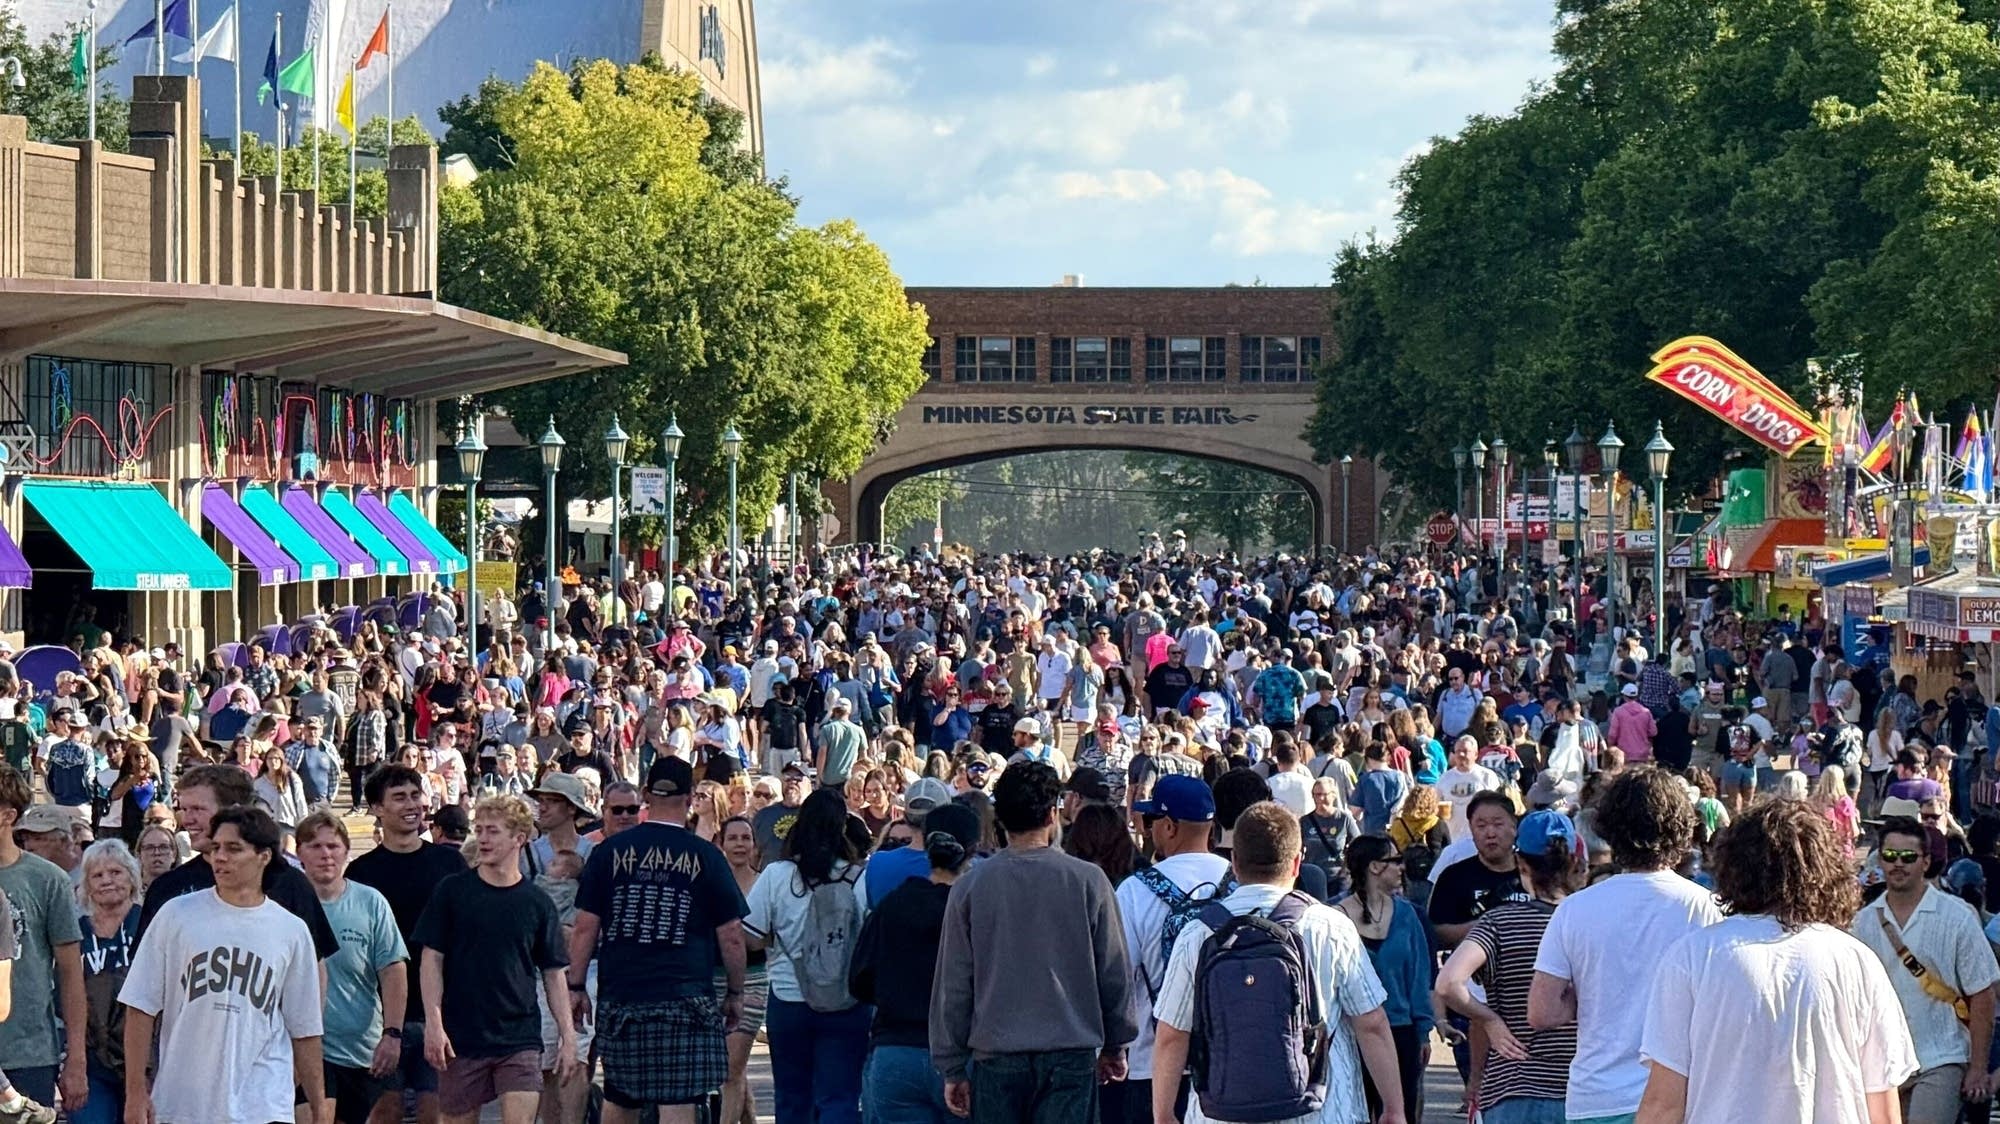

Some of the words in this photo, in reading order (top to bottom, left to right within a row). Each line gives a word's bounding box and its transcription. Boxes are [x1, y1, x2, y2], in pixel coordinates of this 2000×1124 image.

[1676, 363, 1736, 407] CORN
[1740, 402, 1802, 446] DOGS
[922, 406, 1077, 425] MINNESOTA
[1082, 406, 1165, 425] STATE
[1172, 406, 1252, 425] FAIR
[1429, 523, 1453, 535] STOP
[1970, 601, 1987, 609] OLD
[613, 845, 637, 880] DEF
[639, 845, 702, 882] LEPPARD
